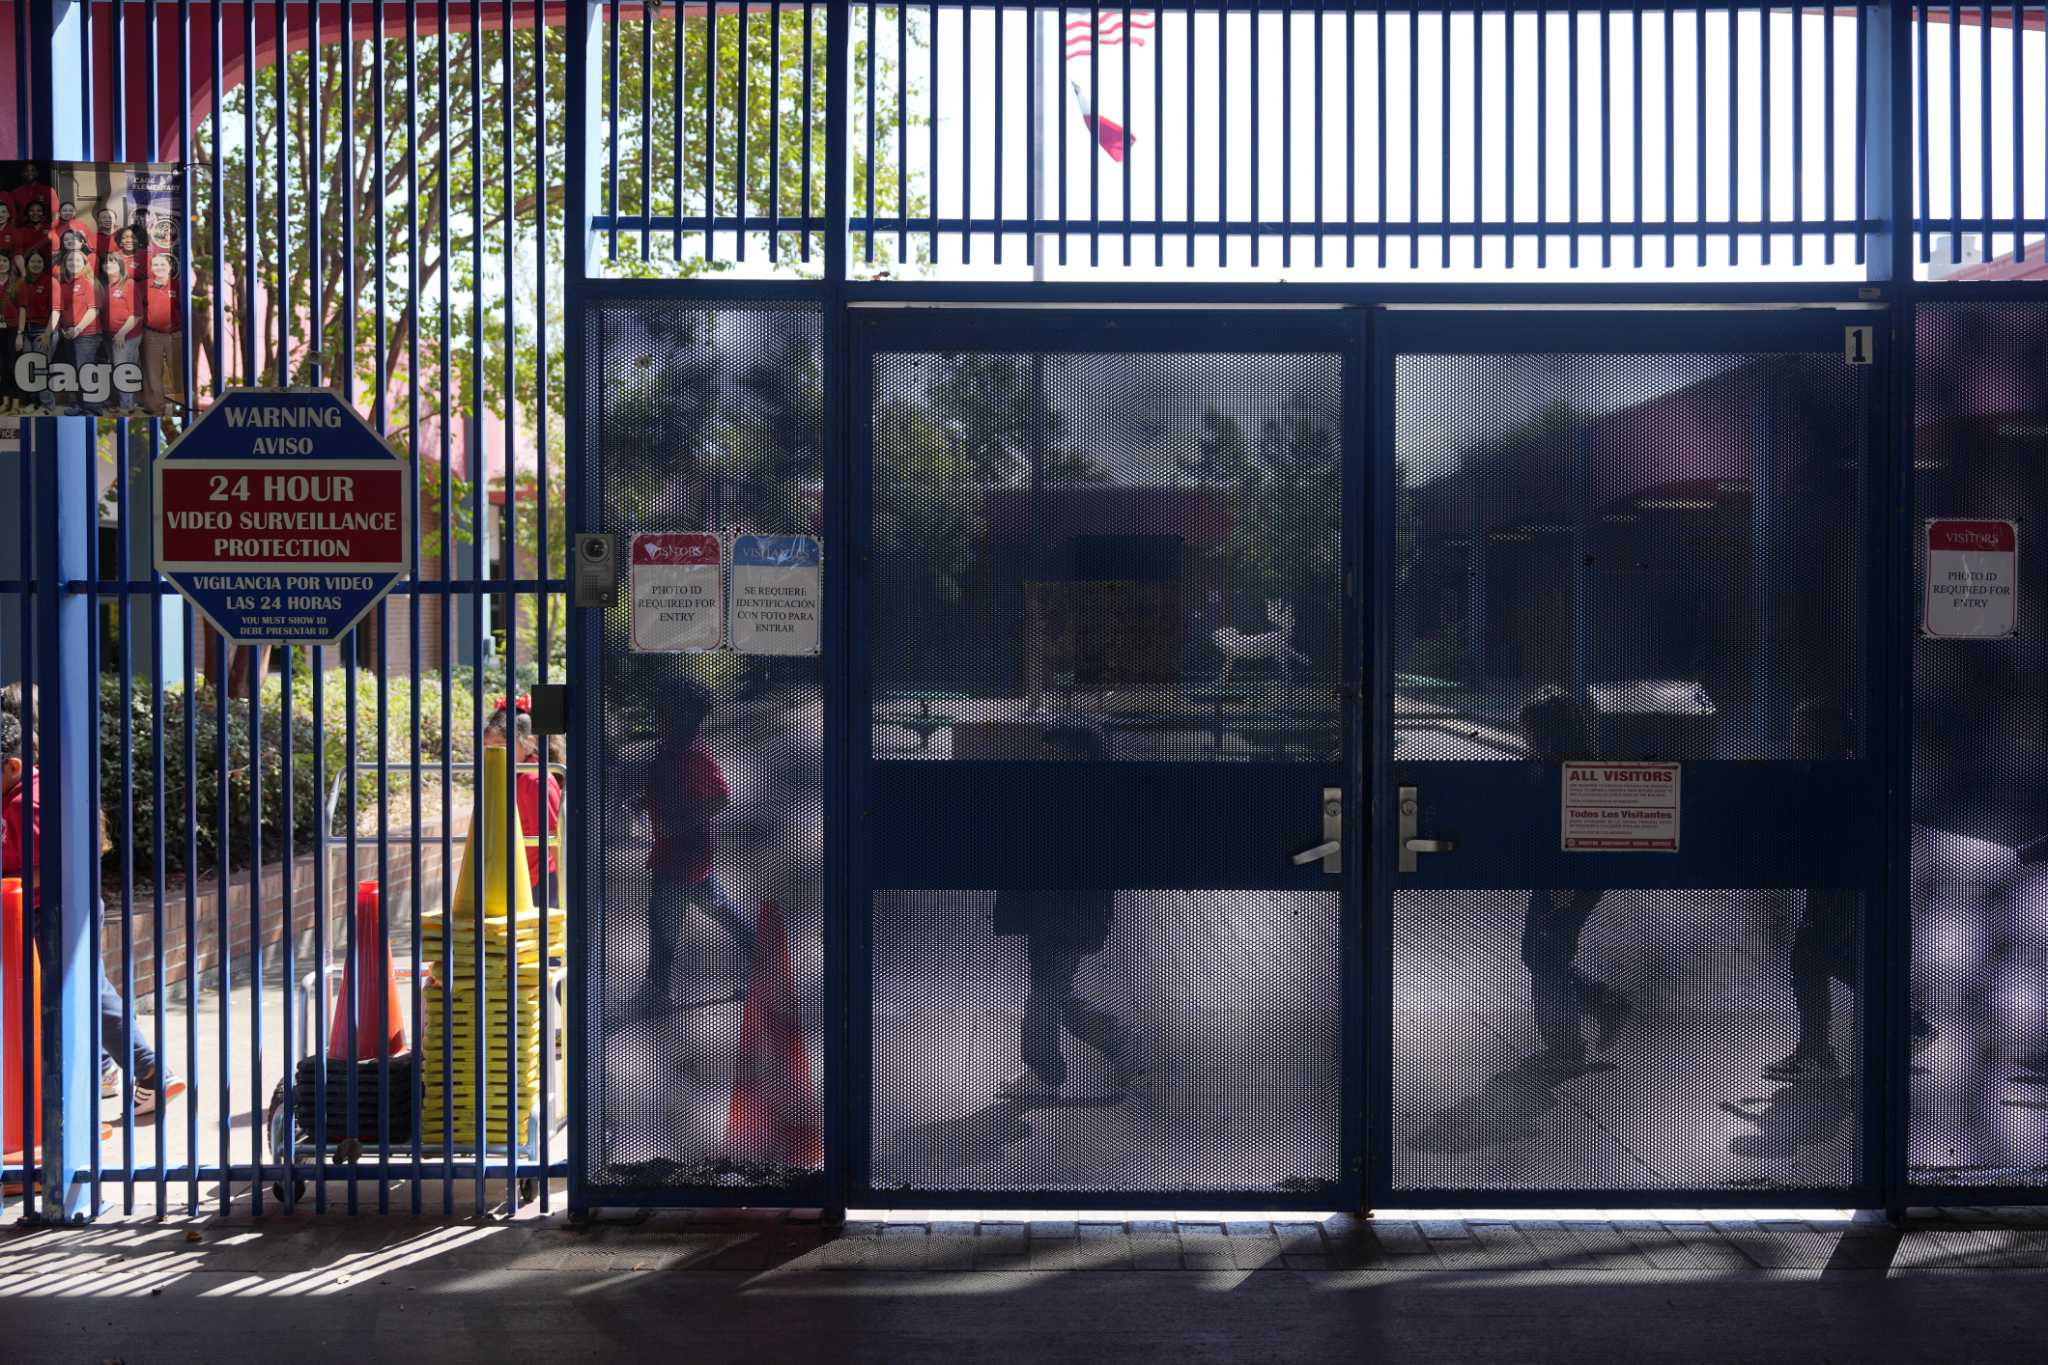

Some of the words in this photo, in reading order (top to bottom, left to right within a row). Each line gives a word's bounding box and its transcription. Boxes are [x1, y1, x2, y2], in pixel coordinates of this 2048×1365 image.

[1852, 329, 1866, 362] 1
[14, 352, 142, 403] Cage
[224, 406, 341, 428] WARNING
[252, 437, 314, 455] AVISO
[208, 475, 251, 502] 24
[263, 475, 355, 502] HOUR
[167, 511, 232, 529] VIDEO
[239, 511, 397, 530] SURVEILLANCE
[1946, 532, 1999, 545] VISITORS
[214, 538, 350, 557] PROTECTION
[1948, 571, 1982, 582] PHOTO
[1985, 572, 1998, 582] ID
[193, 576, 282, 590] VIGILANCIA
[287, 577, 320, 590] POR
[325, 577, 374, 590] VIDEO
[651, 585, 688, 595] PHOTO
[690, 586, 703, 595] ID
[744, 586, 756, 596] SE
[758, 586, 807, 597] REQUIERE
[1990, 585, 2010, 595] FOR
[226, 597, 255, 610] LAS
[260, 597, 282, 610] 24
[287, 597, 342, 610] HORAS
[638, 599, 693, 609] REQUIRED
[695, 599, 716, 608] FOR
[1953, 599, 1988, 608] ENTRY
[241, 616, 260, 625] YOU
[262, 616, 285, 625] MUST
[288, 616, 316, 625] SHOW
[317, 616, 327, 625] ID
[659, 612, 695, 622] ENTRY
[737, 610, 758, 620] CON
[760, 611, 787, 621] FOTO
[788, 612, 814, 621] PARA
[240, 627, 264, 635] DEBE
[266, 627, 316, 635] PRESENTAR
[318, 627, 329, 635] ID
[755, 623, 795, 633] ENTRAR
[1569, 771, 1598, 782] ALL
[1604, 770, 1673, 783] VISITORS
[1569, 810, 1599, 819] Todos
[1602, 810, 1619, 819] Los
[1621, 810, 1672, 819] Visitantes
